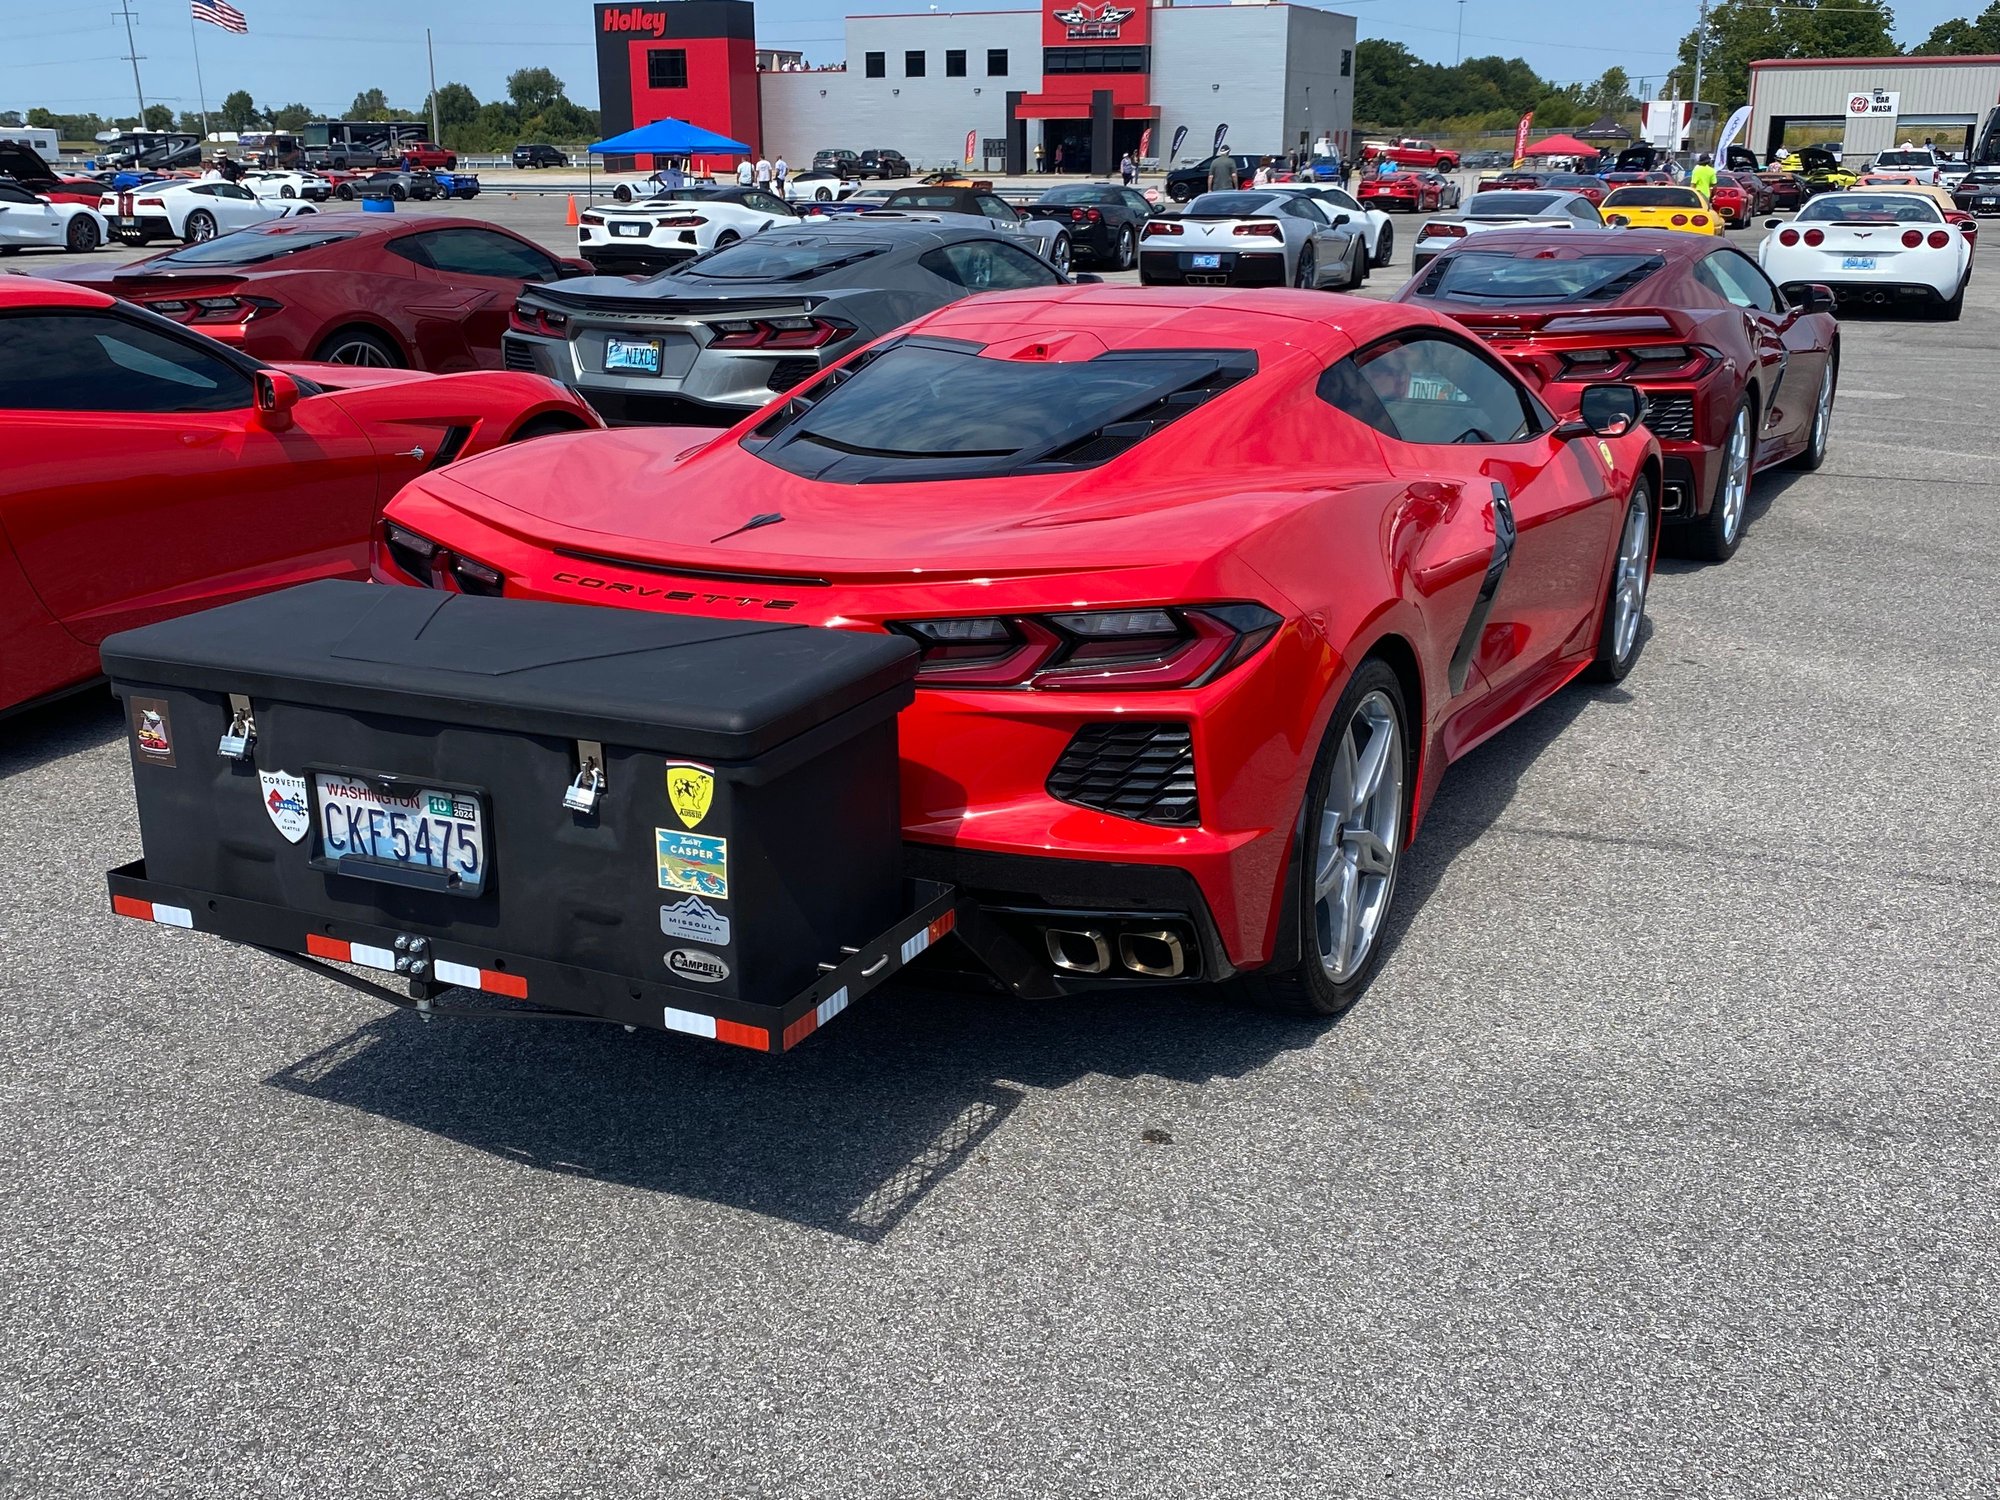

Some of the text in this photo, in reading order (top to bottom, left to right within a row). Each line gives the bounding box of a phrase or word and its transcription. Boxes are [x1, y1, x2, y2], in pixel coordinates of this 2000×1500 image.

[603, 8, 665, 37] Holley
[586, 312, 677, 321] CORVETTE
[552, 572, 799, 611] CORVETTE
[262, 776, 306, 788] CORVETTE
[430, 798, 447, 812] 10
[453, 809, 474, 819] 2024
[325, 802, 478, 873] CKF5475
[670, 844, 714, 860] CASPER
[668, 917, 721, 932] MISSOULA
[669, 950, 724, 975] CAMPBELL
